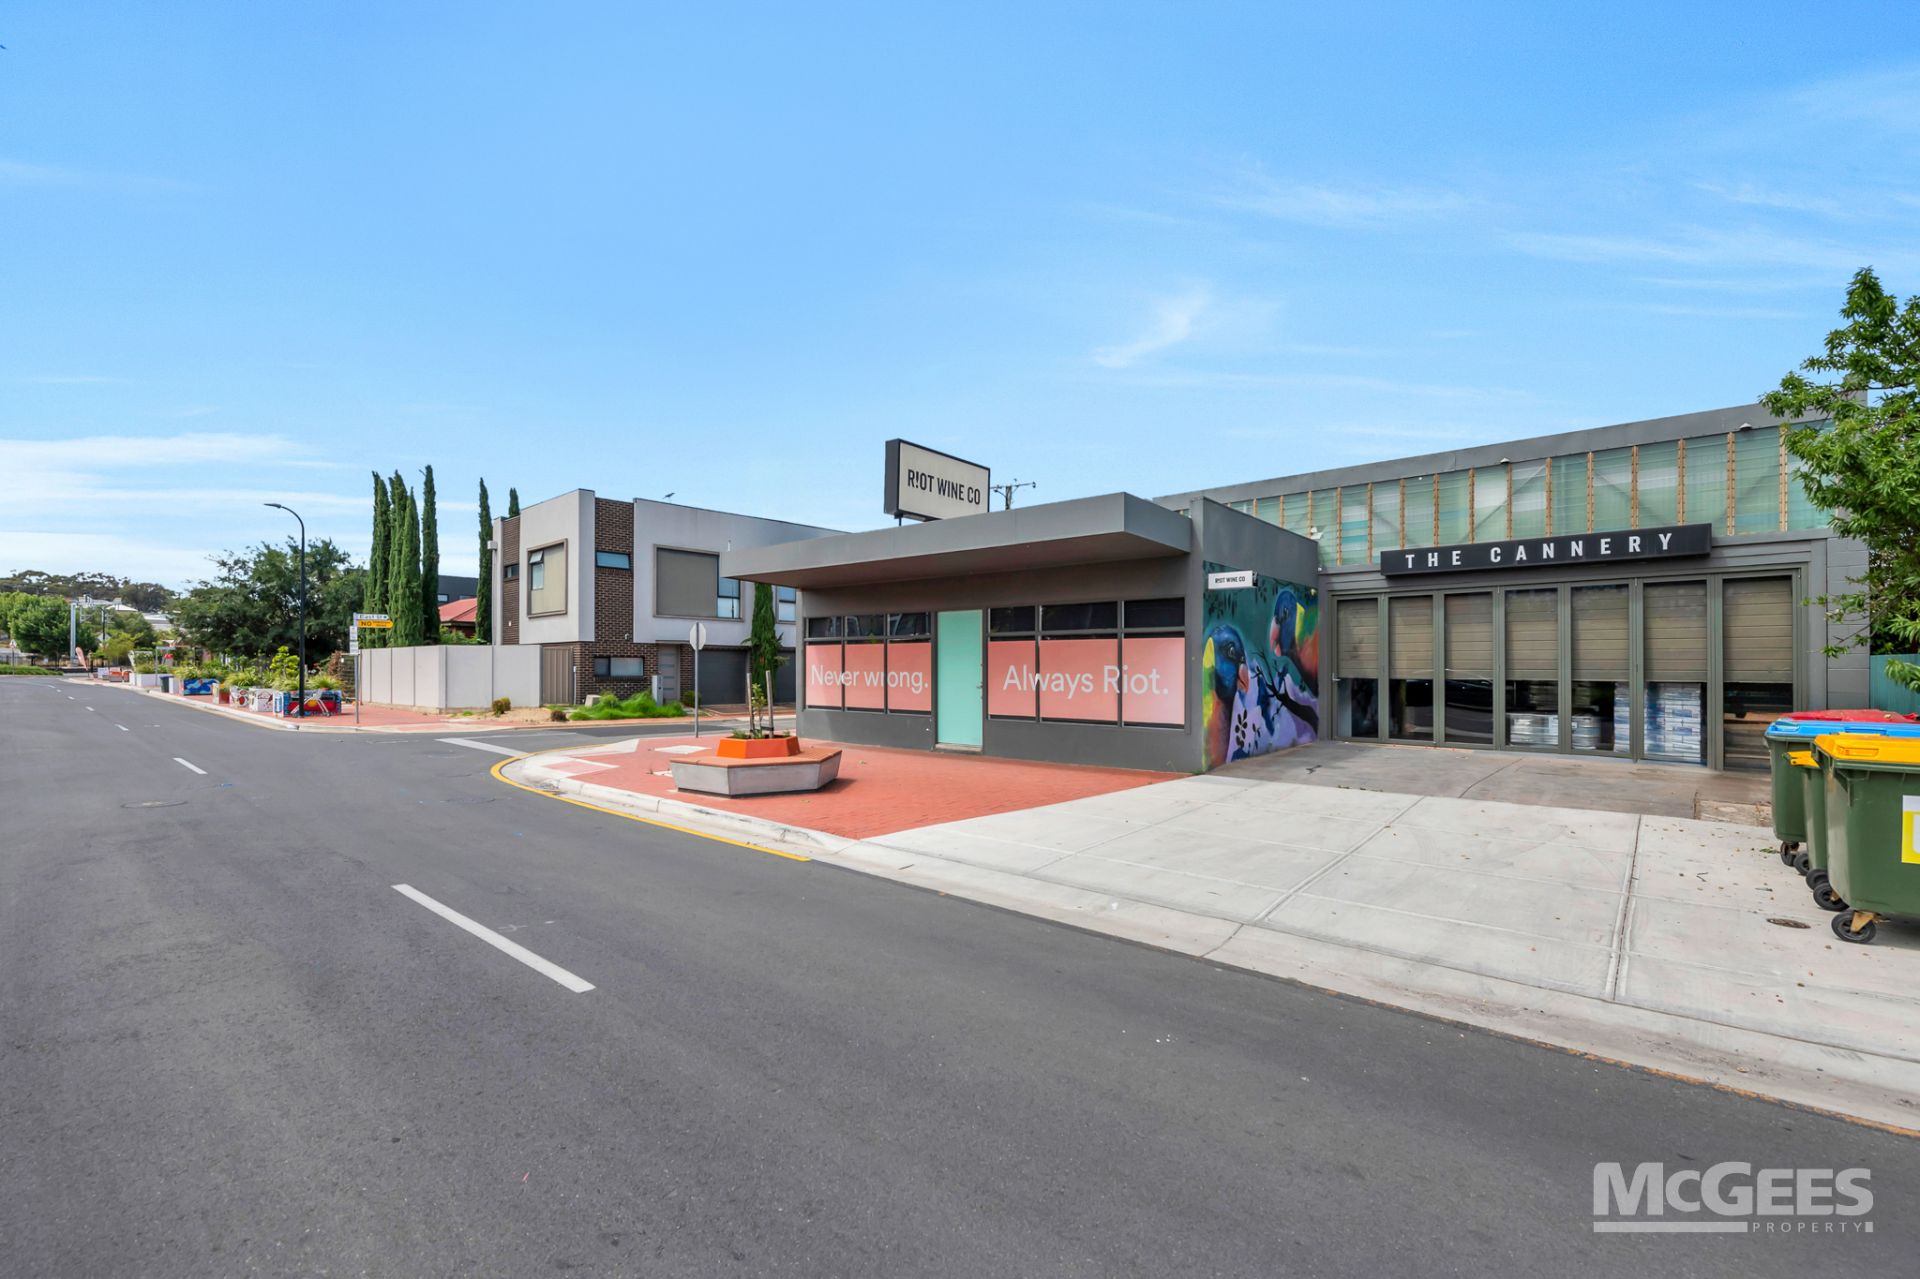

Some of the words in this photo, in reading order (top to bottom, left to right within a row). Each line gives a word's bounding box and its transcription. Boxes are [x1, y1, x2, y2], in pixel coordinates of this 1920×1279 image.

[936, 477, 965, 501] WINE
[966, 486, 981, 505] CO
[1405, 550, 1462, 569] THE
[1489, 532, 1673, 563] CANNERY
[810, 664, 860, 687] Never
[1002, 664, 1094, 700] Always
[1103, 664, 1169, 695] Riot.
